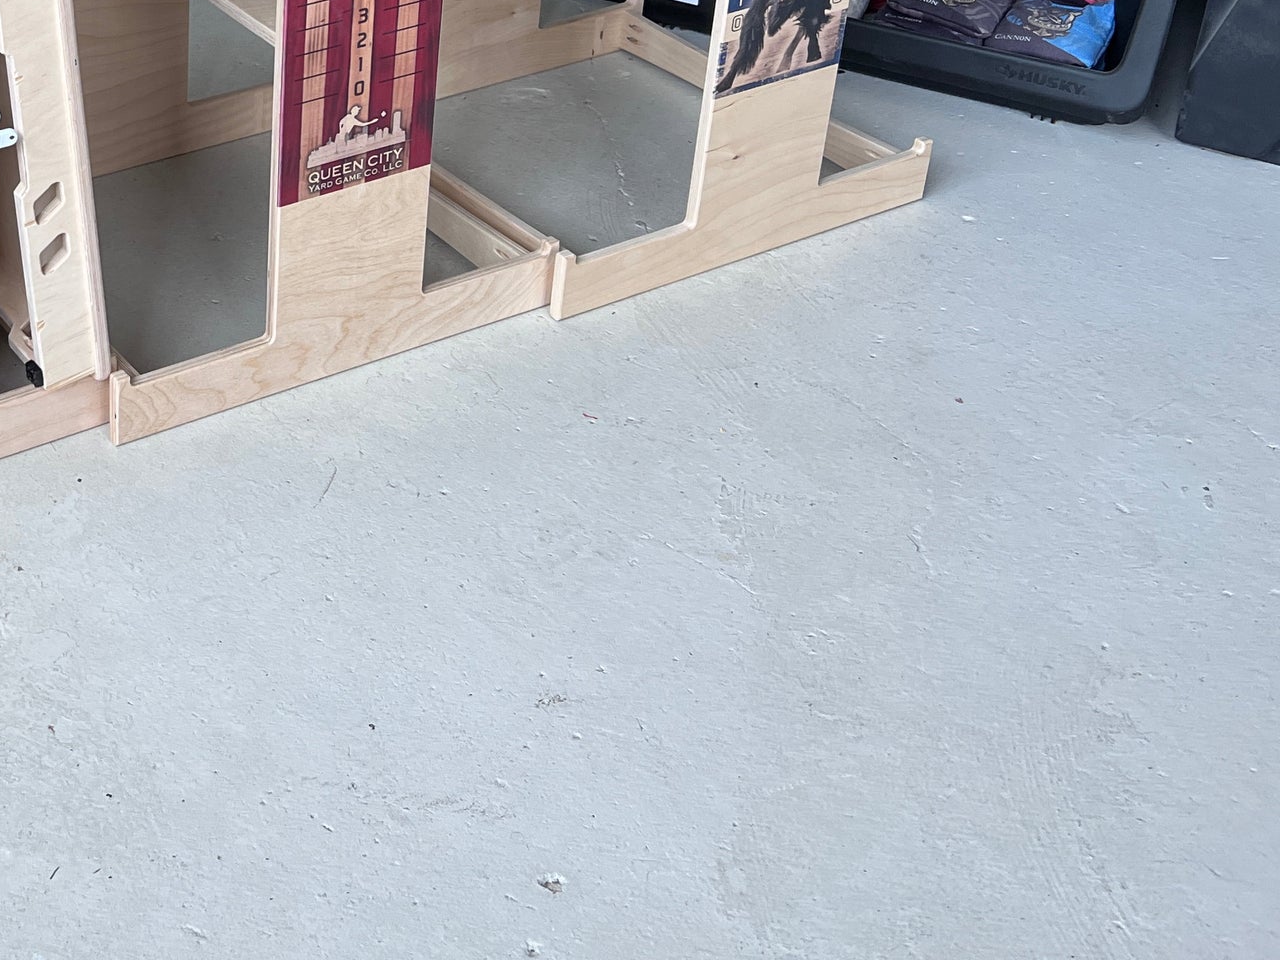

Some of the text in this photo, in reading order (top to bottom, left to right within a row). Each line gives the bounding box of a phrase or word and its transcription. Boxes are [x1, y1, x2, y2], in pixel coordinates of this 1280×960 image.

[358, 8, 369, 25] 3
[734, 18, 741, 29] 0
[994, 33, 1032, 42] CANNON
[354, 80, 365, 96] 0
[1021, 69, 1085, 95] HUSKY
[309, 147, 403, 184] QUEEN CITY
[308, 181, 333, 192] YARD
[335, 173, 362, 185] GAME
[382, 160, 403, 172] LLC
